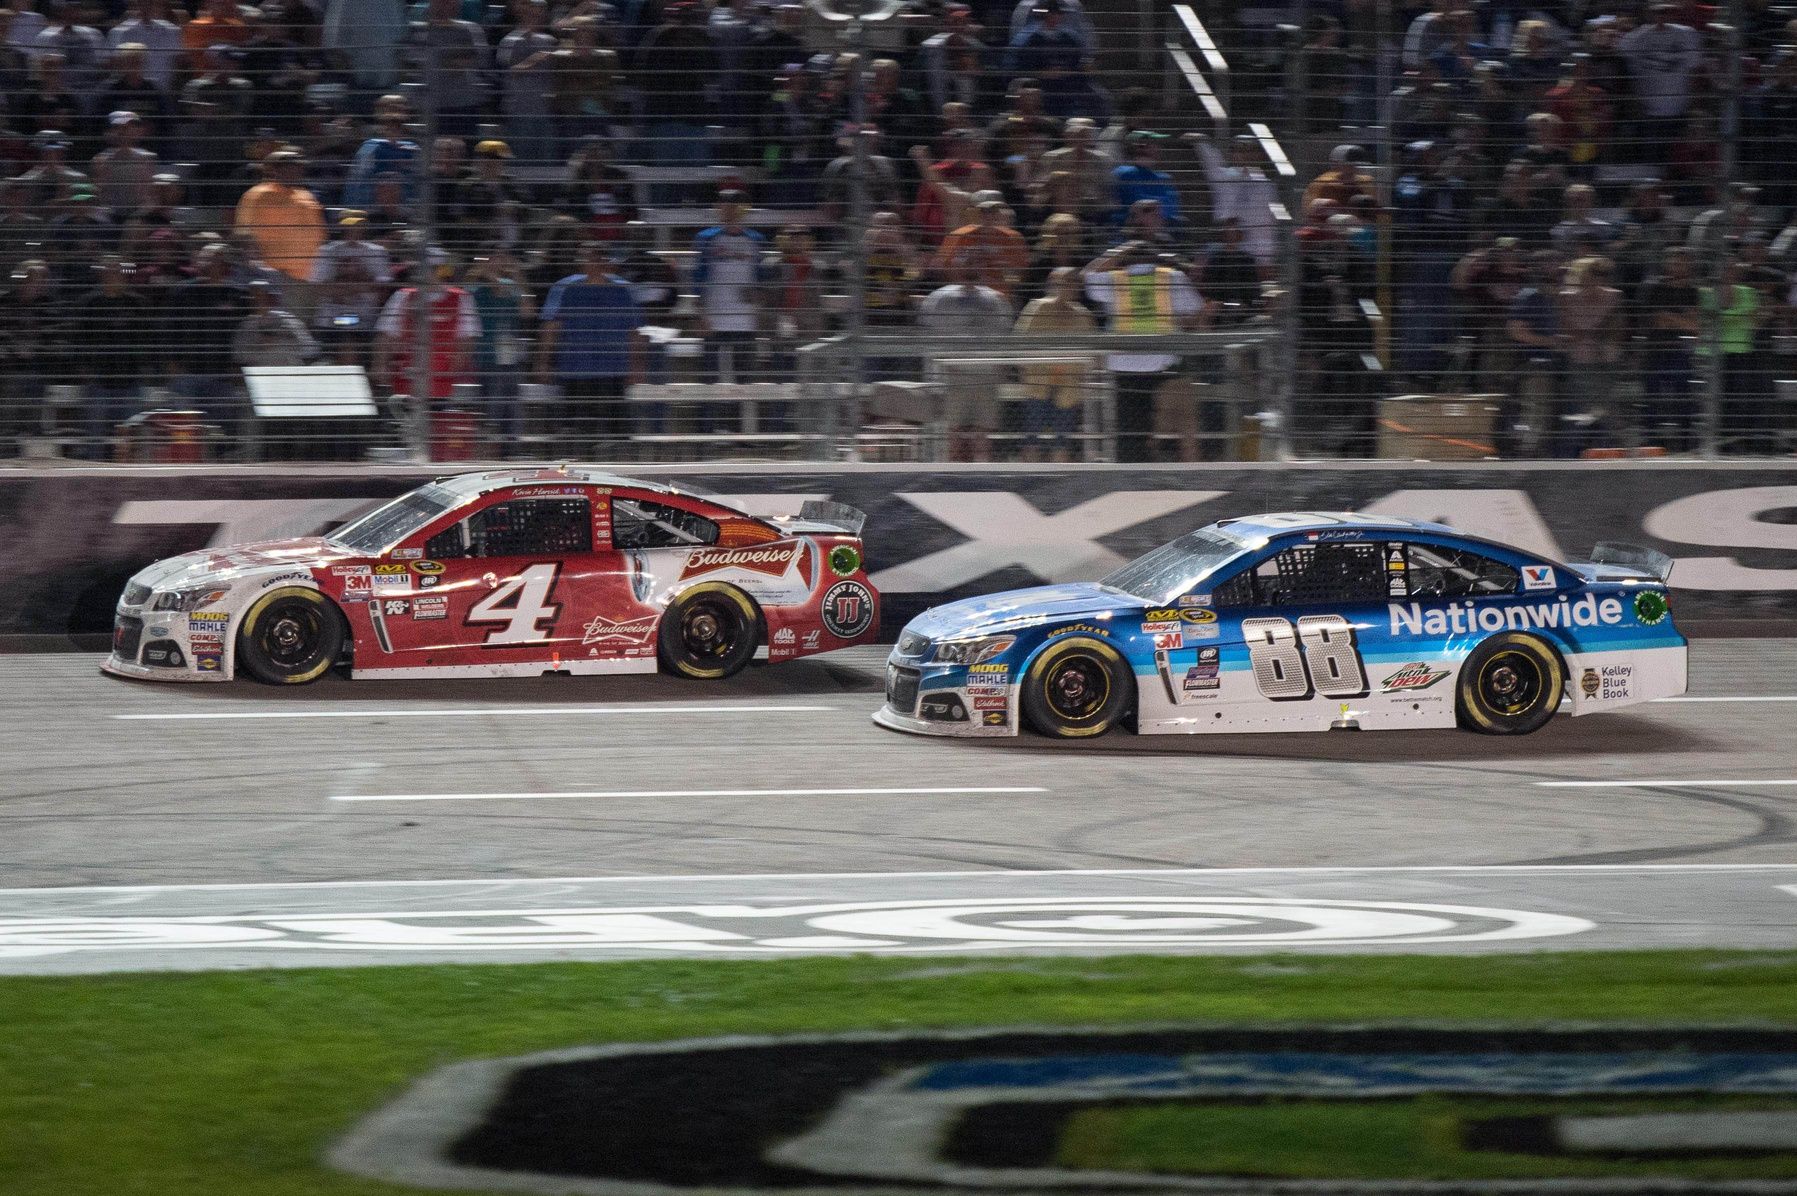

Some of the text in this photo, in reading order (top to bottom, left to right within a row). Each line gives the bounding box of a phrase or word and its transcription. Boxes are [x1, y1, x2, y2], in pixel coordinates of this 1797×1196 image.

[687, 547, 804, 568] Budweiser
[347, 576, 372, 590] 3M
[374, 575, 398, 585] Mobil
[467, 563, 559, 646] 4
[825, 585, 871, 610] JIMMY JOHN'S
[1634, 590, 1666, 605] AMERICAN
[1388, 592, 1622, 636] Nationwide
[1637, 610, 1668, 625] ETHANOL
[189, 622, 226, 631] MAHLE
[582, 622, 657, 635] Budweiser
[1047, 624, 1109, 638] GOODYEAR
[1156, 633, 1182, 649] 3M
[1241, 615, 1365, 699] 88
[968, 664, 1009, 673] MOOG
[1601, 666, 1632, 677] Kelley
[967, 675, 1007, 684] MAHLE
[1602, 677, 1627, 688] Blue
[1603, 688, 1629, 699] Book
